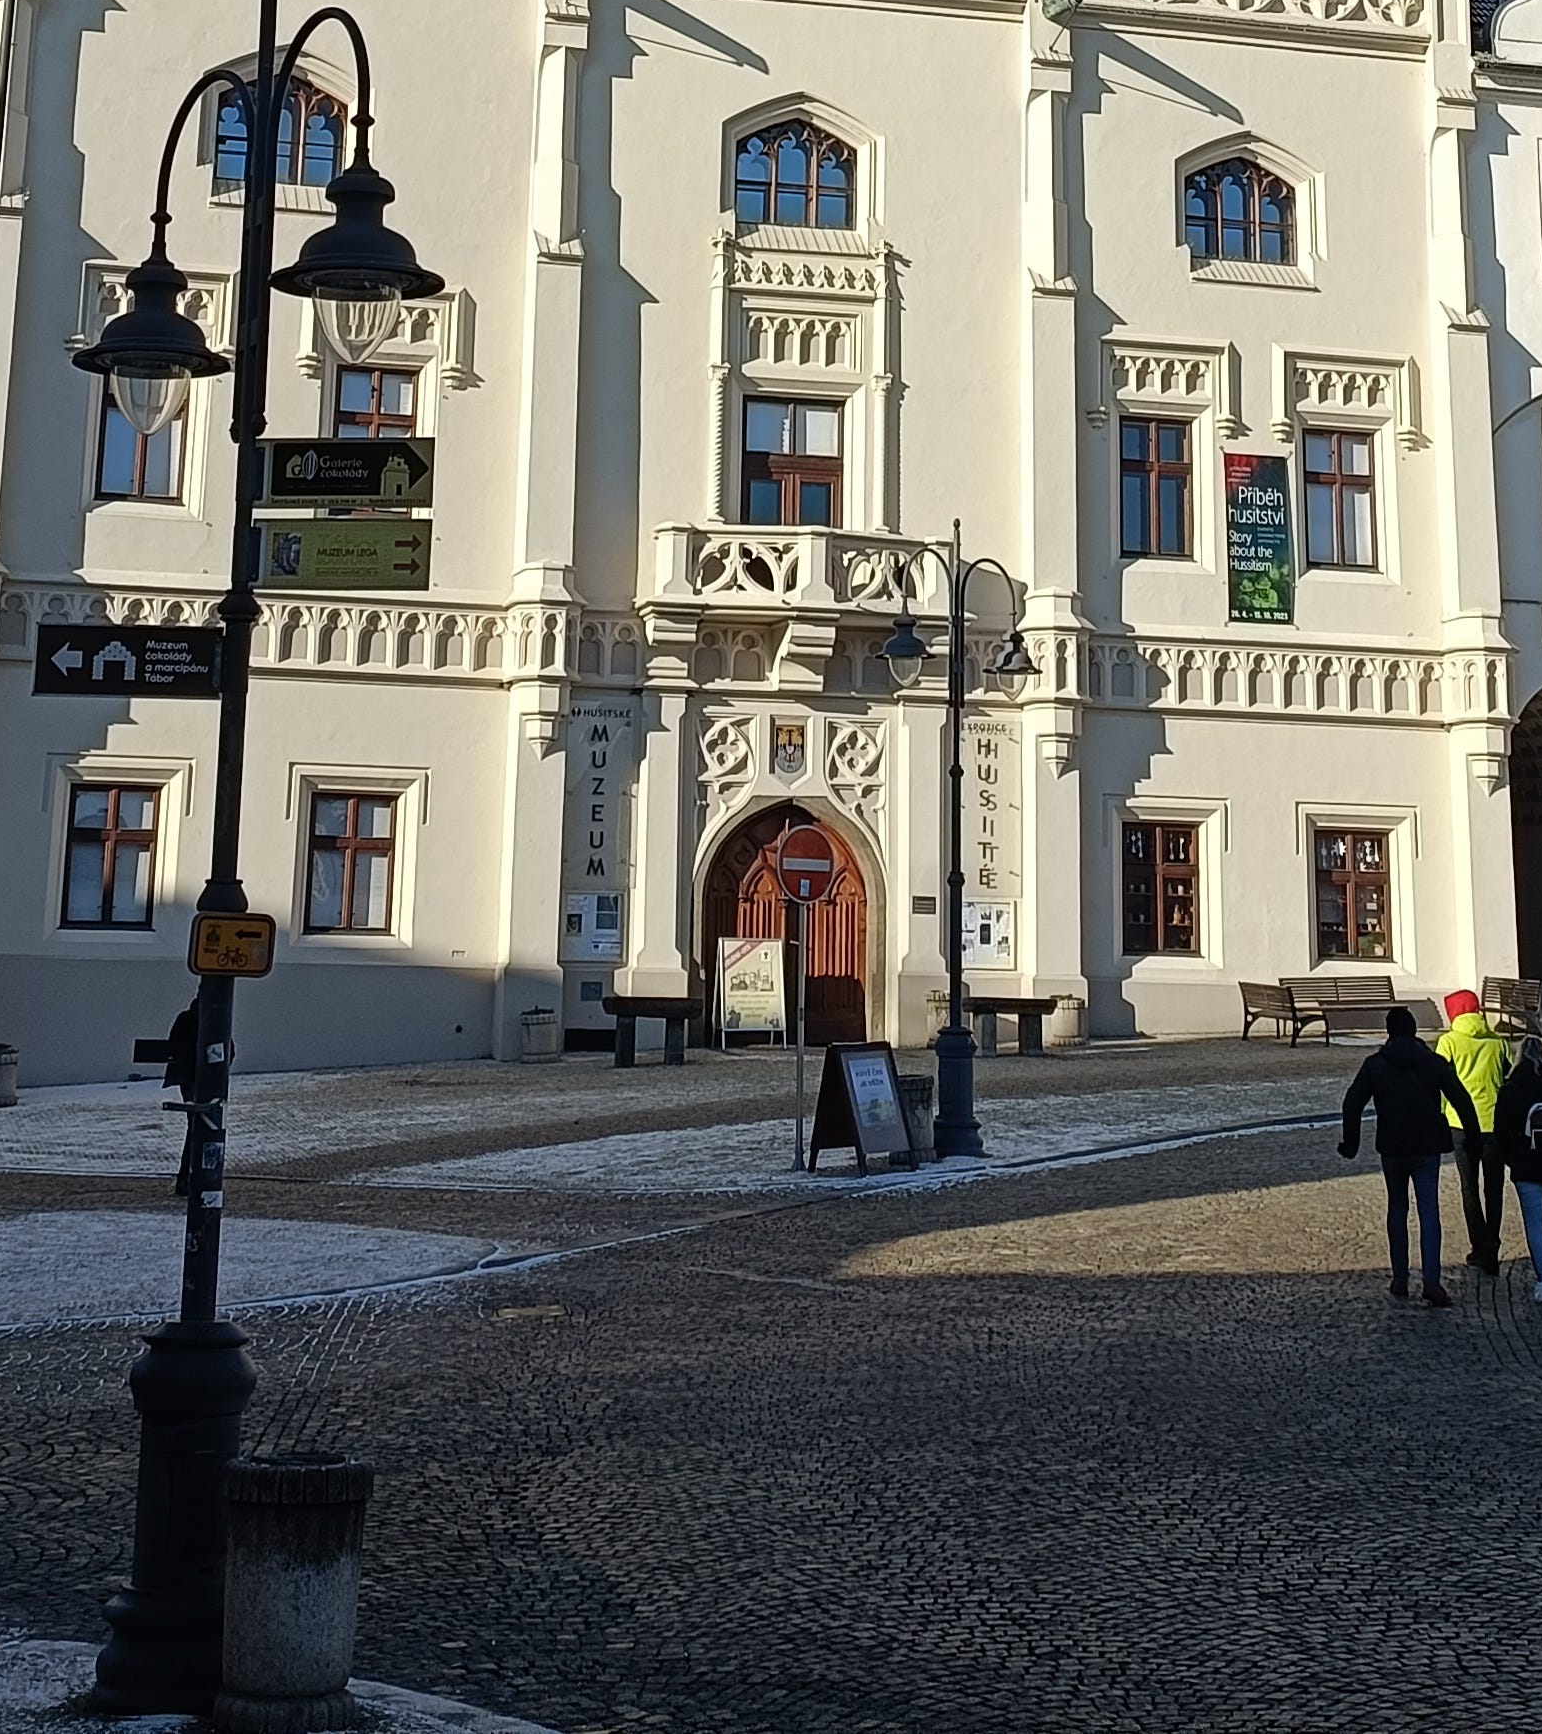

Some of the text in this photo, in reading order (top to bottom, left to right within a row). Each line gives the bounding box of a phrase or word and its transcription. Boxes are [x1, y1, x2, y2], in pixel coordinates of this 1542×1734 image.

[319, 455, 363, 468] Galerie
[319, 467, 370, 481] čokolády
[1238, 486, 1284, 507] Příběh
[1228, 504, 1285, 526] husitství
[1229, 530, 1252, 546] Story
[316, 548, 379, 558] MUZEUM LEGA
[1229, 545, 1274, 558] about the
[1229, 558, 1273, 573] Hussitism
[145, 639, 189, 650] Muzeum
[145, 651, 193, 663] čokolády
[144, 663, 209, 674] a marcipánu
[144, 673, 175, 683] Tábor
[583, 707, 632, 719] HUSITSKÉ
[586, 724, 610, 876] MUZEUM
